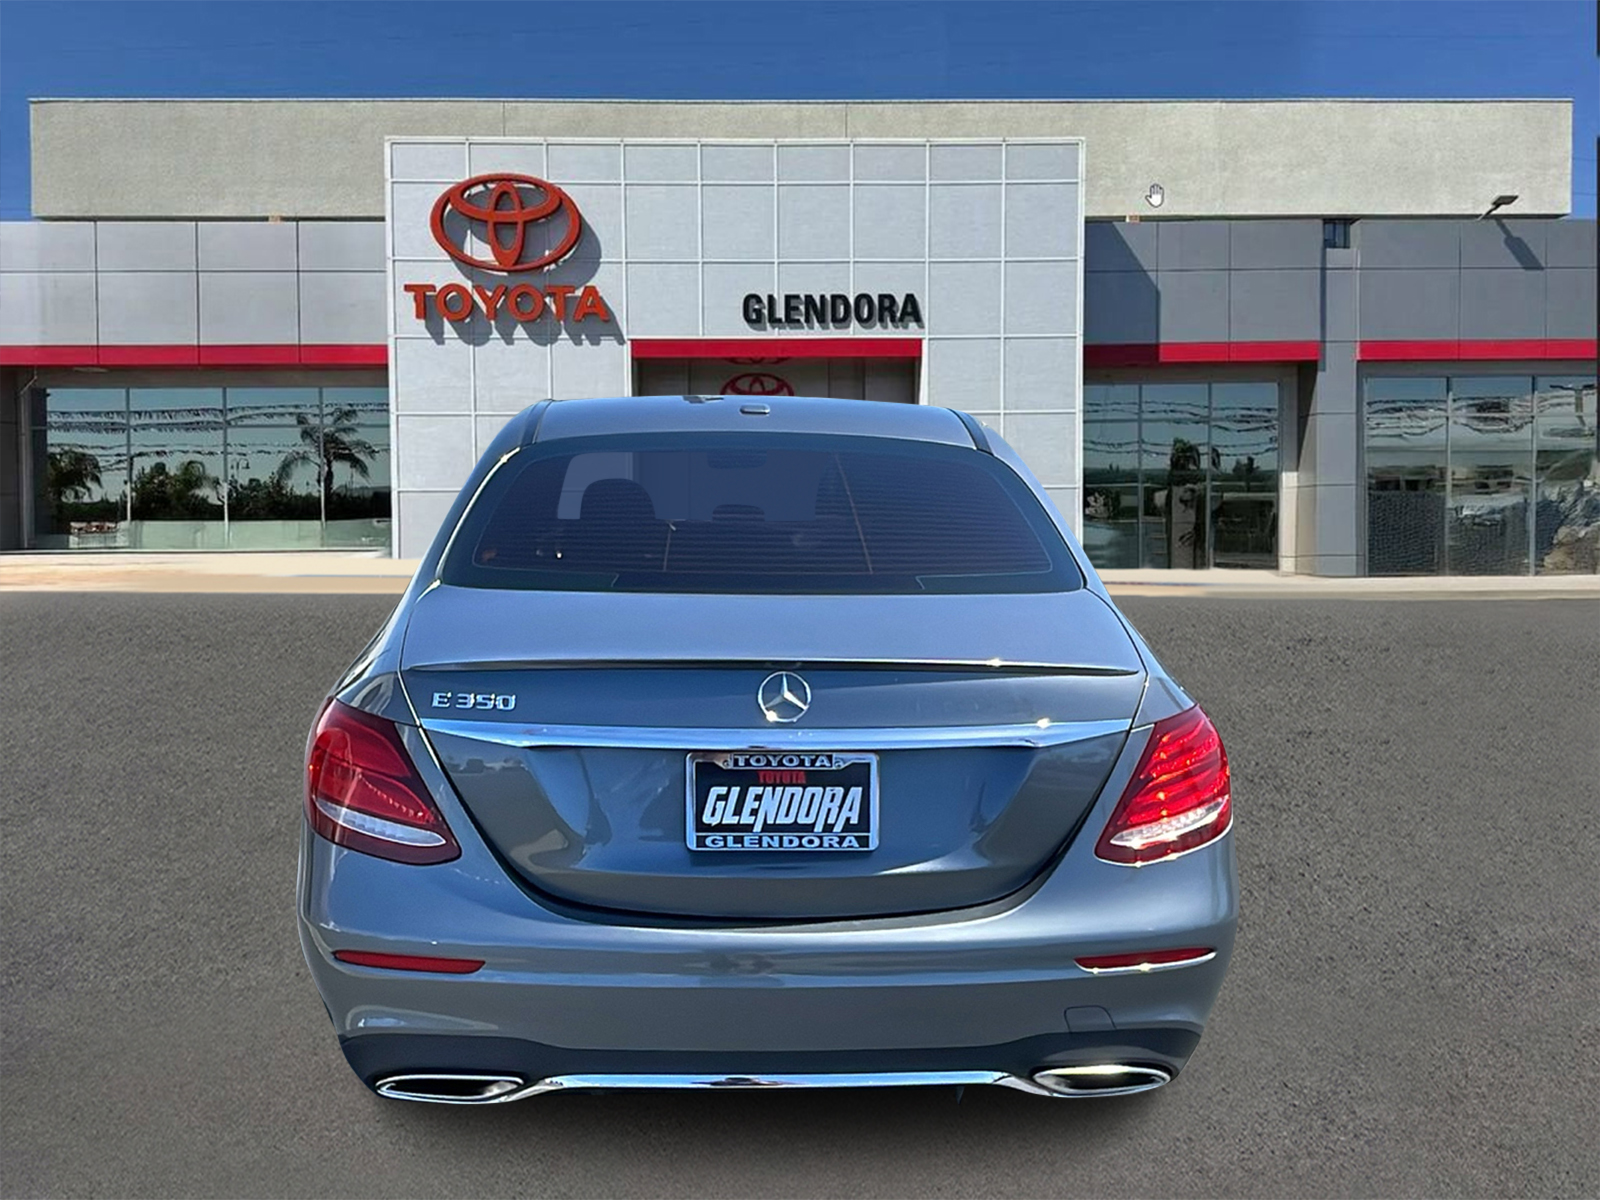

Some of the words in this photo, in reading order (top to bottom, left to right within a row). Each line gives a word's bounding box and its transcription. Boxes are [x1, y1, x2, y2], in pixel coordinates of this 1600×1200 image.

[403, 283, 610, 322] TOYOTA
[742, 293, 923, 324] GLENDORA
[432, 691, 452, 708] E
[455, 692, 517, 711] 350
[734, 755, 832, 767] TOYOTA
[757, 770, 807, 784] TOYOTA
[702, 786, 863, 833] GLENDORA
[704, 835, 860, 849] GLENDORA
